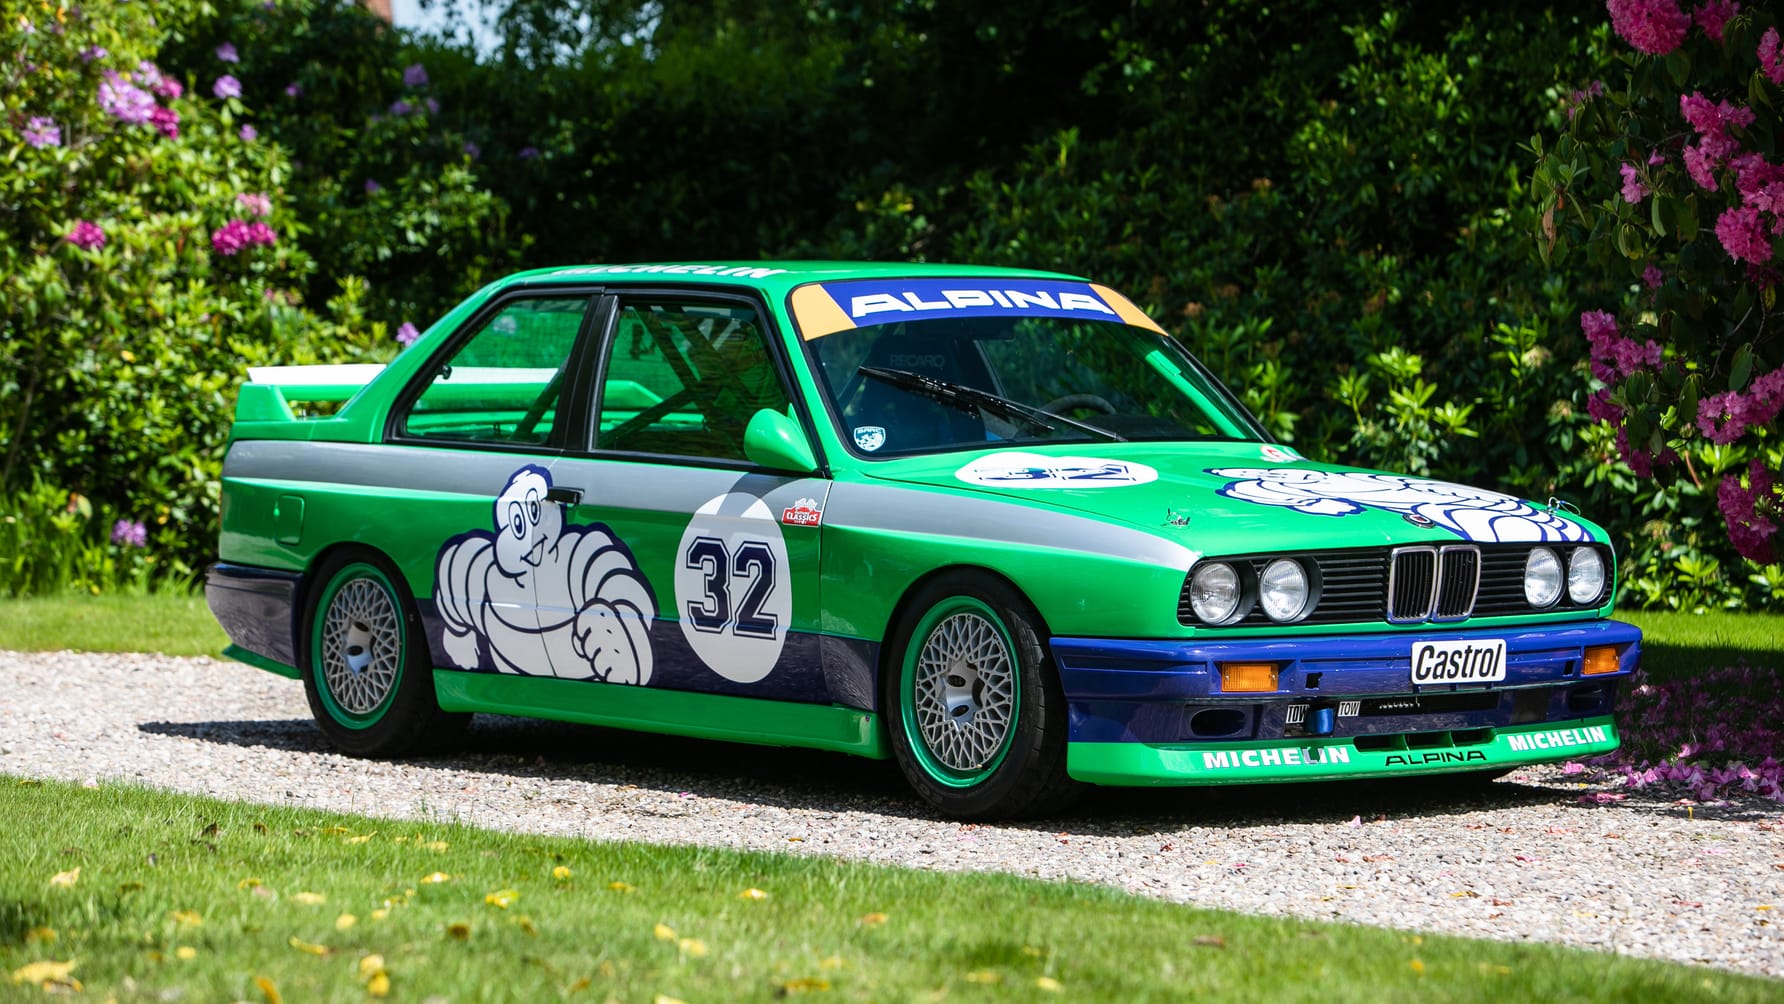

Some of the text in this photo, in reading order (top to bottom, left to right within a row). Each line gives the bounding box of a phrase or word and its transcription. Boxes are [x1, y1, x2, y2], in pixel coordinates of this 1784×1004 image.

[551, 264, 787, 278] MICHELIN
[851, 290, 1116, 318] ALPINA
[890, 354, 945, 368] RECARO
[786, 511, 818, 522] CLASSICS
[686, 536, 778, 641] 32
[1415, 644, 1503, 680] Castrol
[1339, 701, 1359, 716] TOW
[1509, 726, 1607, 751] MICHELIN
[1202, 746, 1351, 769] MICHELIN
[1385, 750, 1487, 766] ALPINA
